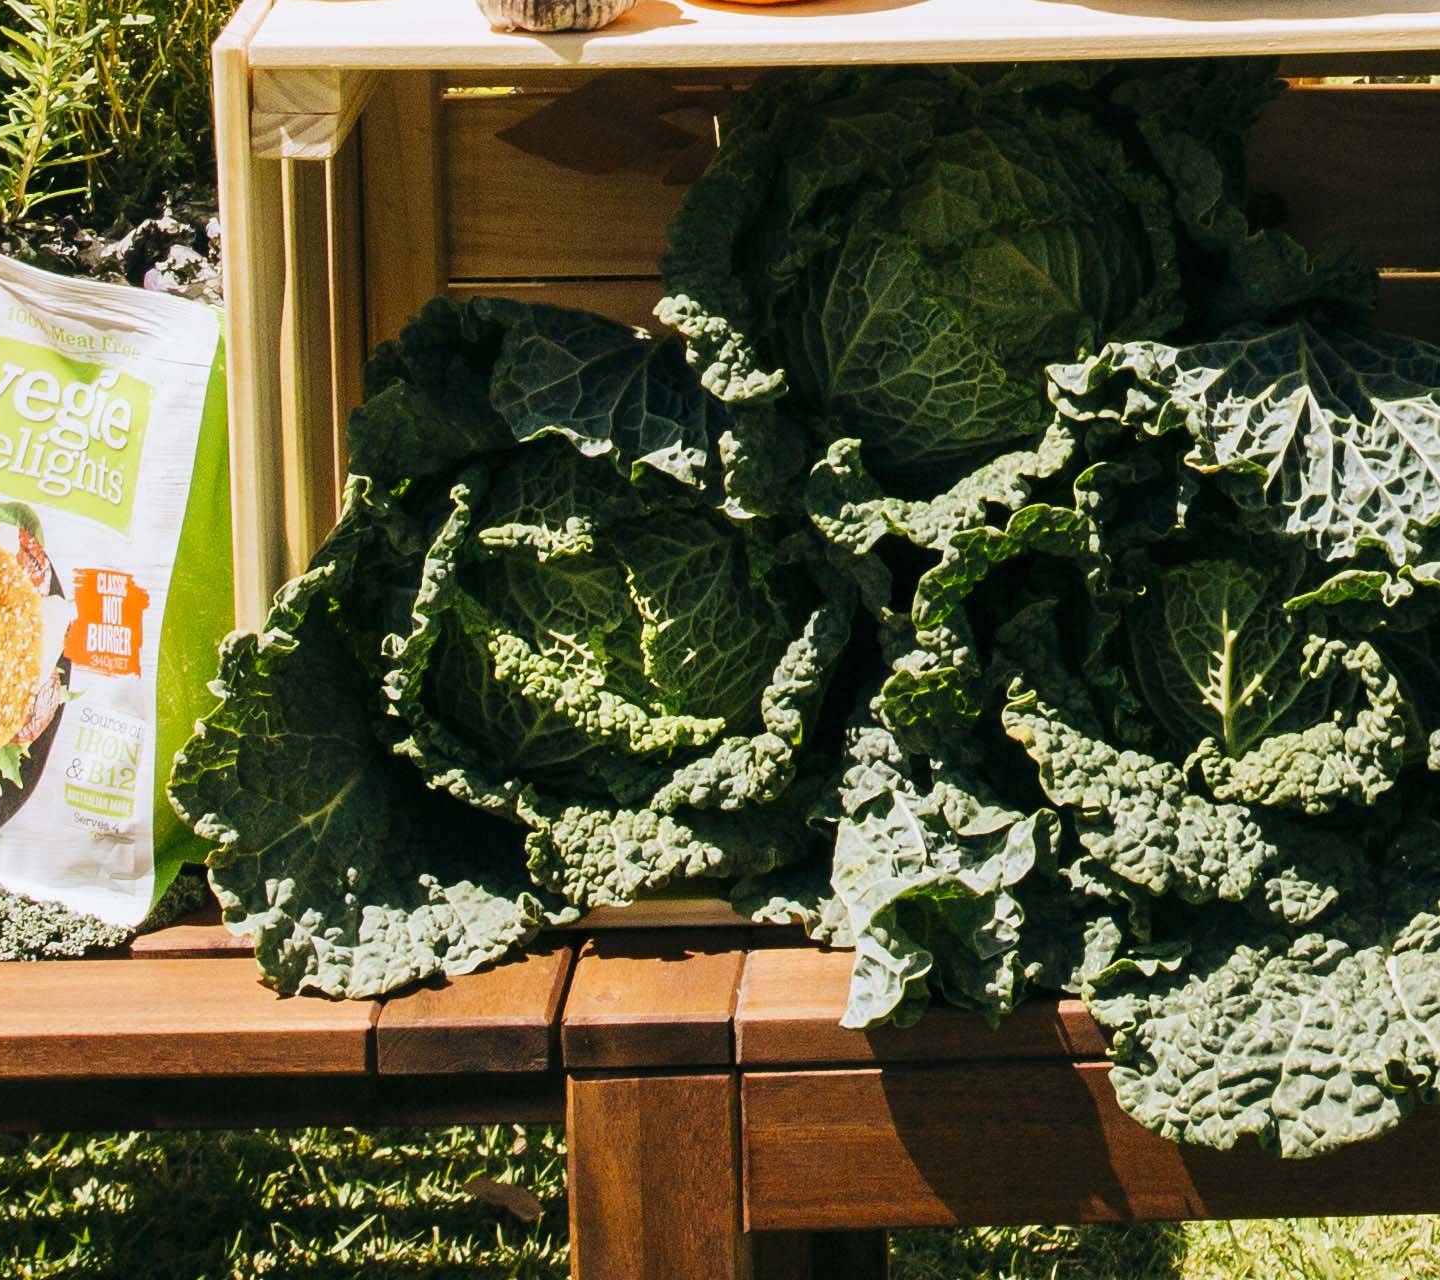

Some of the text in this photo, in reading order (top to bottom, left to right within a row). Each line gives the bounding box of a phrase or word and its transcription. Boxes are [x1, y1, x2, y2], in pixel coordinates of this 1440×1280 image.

[50, 324, 95, 350] Meat
[101, 335, 141, 360] Free
[102, 595, 123, 625] NOT
[86, 623, 132, 656] BURGER
[80, 706, 128, 733] Source
[74, 726, 142, 766] IRON
[65, 758, 137, 793] & B12
[72, 811, 110, 832] Serves
